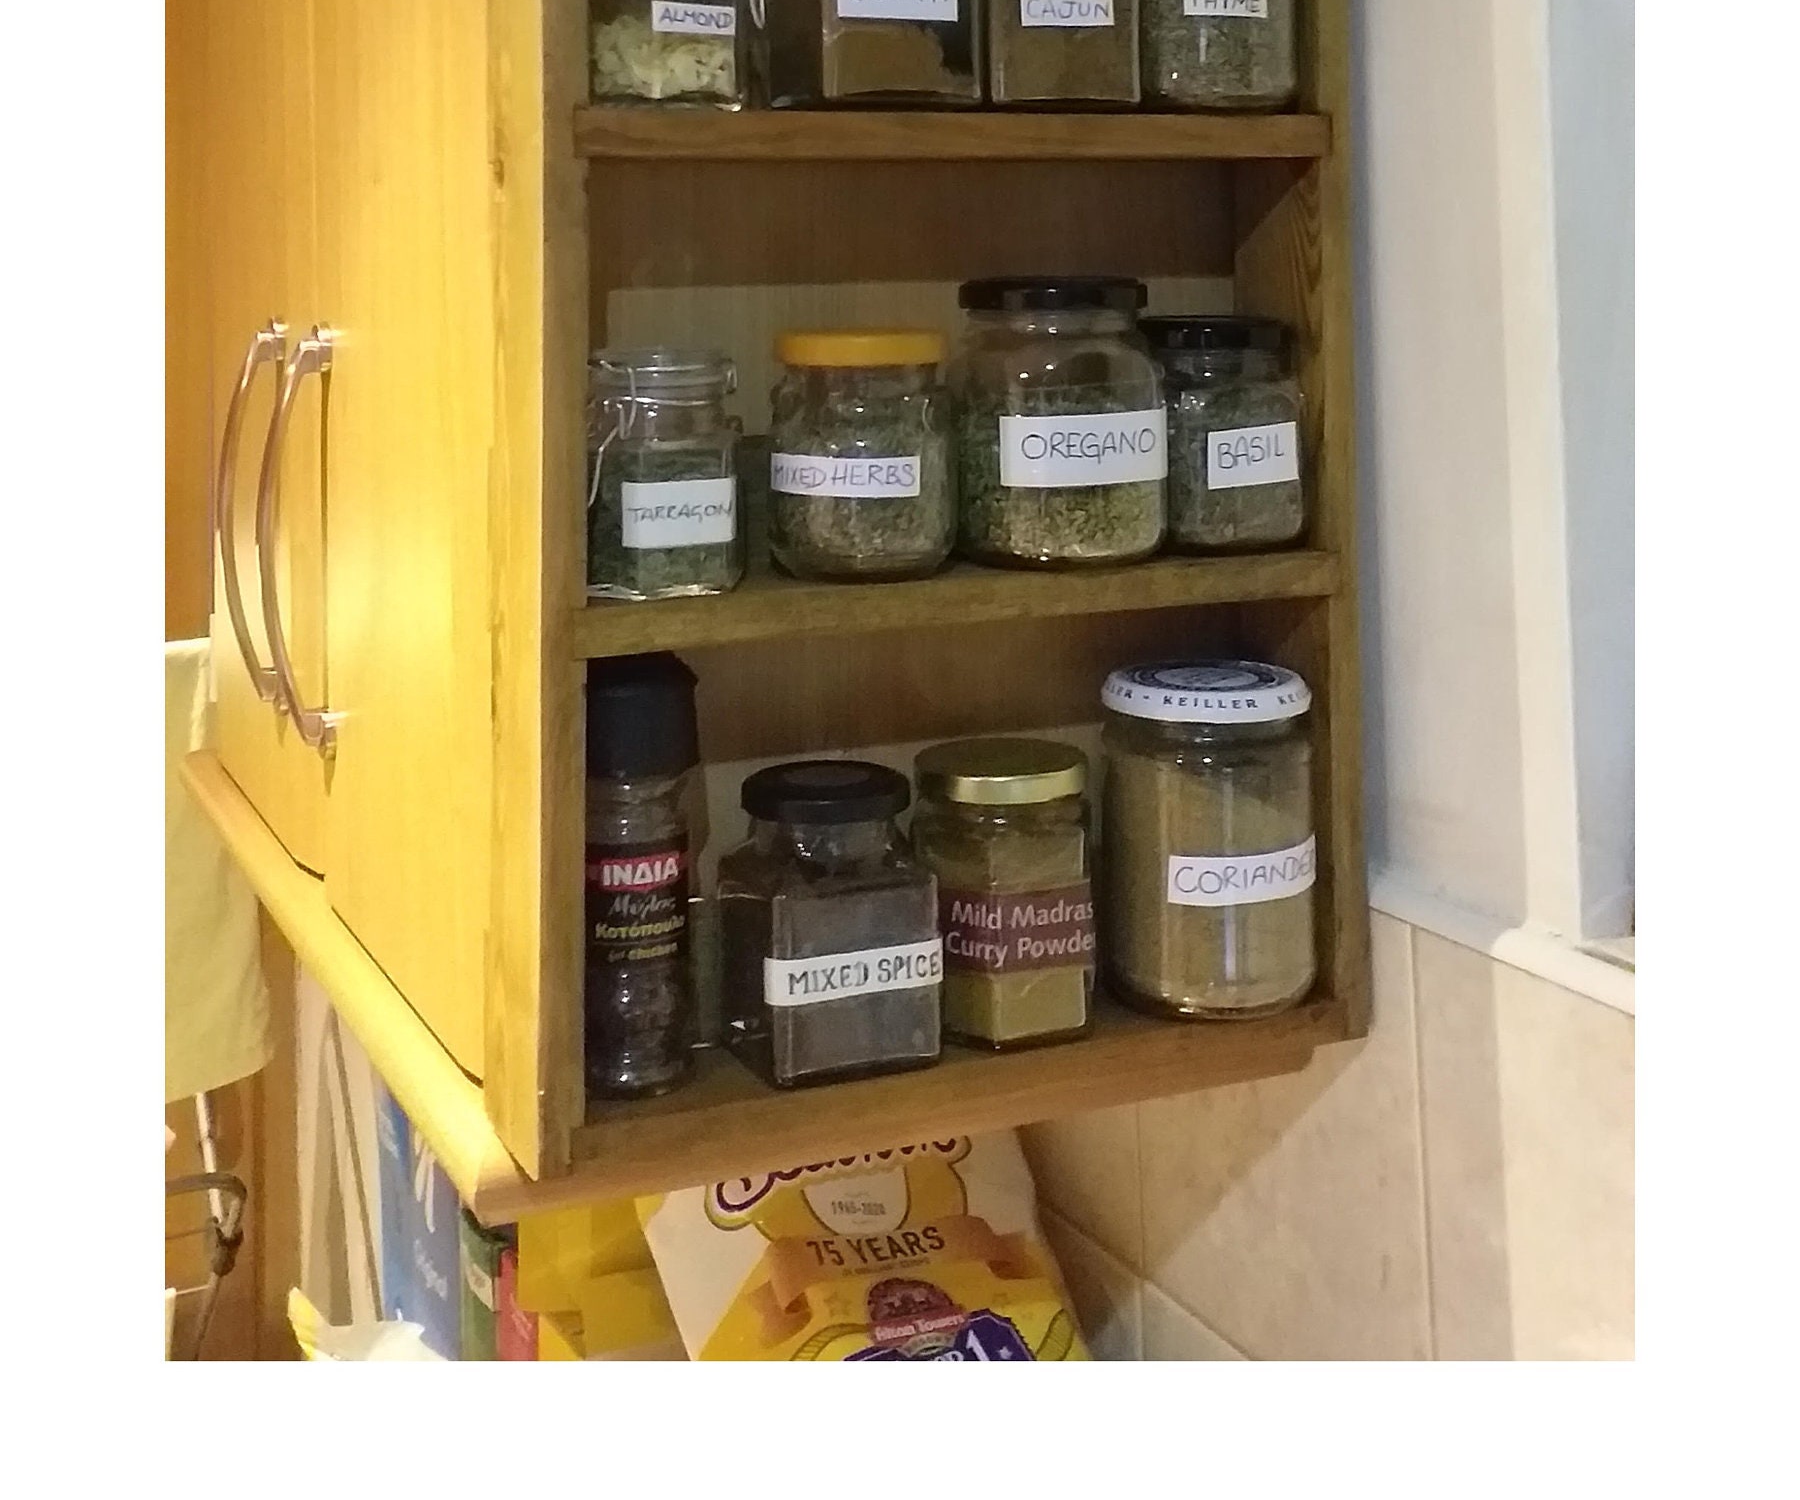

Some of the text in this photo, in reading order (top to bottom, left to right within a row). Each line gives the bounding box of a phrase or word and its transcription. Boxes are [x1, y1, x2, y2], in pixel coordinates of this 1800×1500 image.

[658, 8, 735, 31] ALMOND
[1026, 0, 1110, 20] CAJUN
[1020, 427, 1156, 464] OREGANO
[1216, 434, 1285, 470] BASIL
[772, 461, 917, 489] MIXED HERBS
[627, 503, 733, 524] TARRAGON
[1162, 695, 1258, 709] KEILLER
[951, 899, 1094, 930] Mild Madras
[945, 929, 1096, 968] Curry Powde
[787, 953, 943, 996] MIXED SPICE
[805, 1240, 846, 1267] 75
[846, 1226, 946, 1264] YEARS
